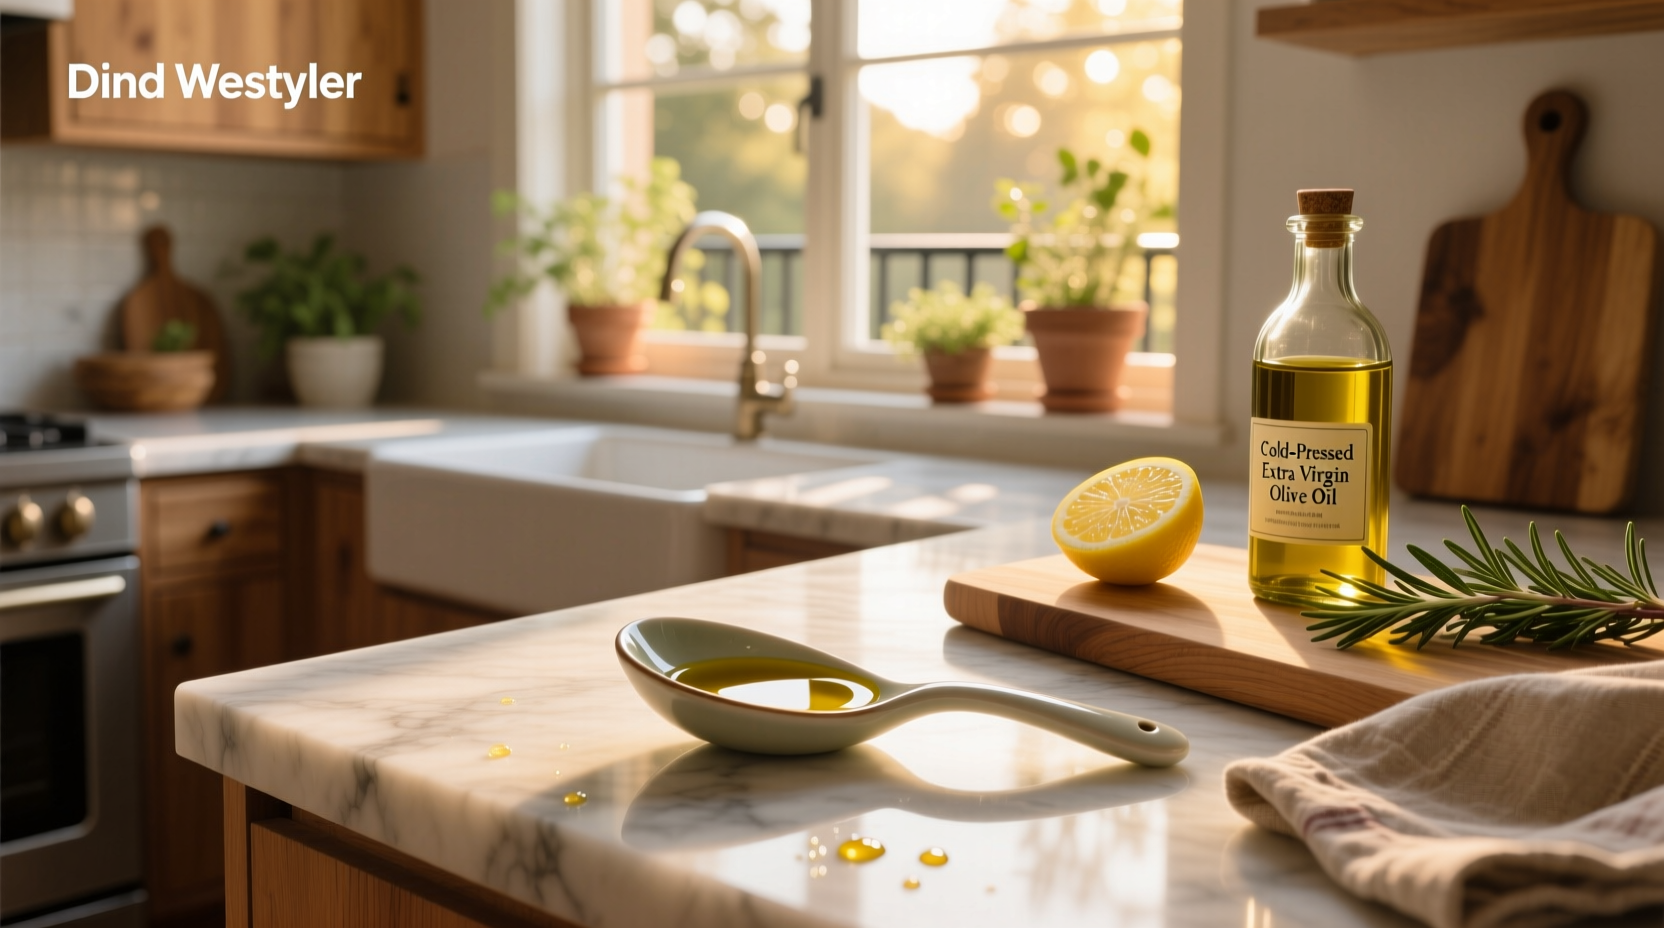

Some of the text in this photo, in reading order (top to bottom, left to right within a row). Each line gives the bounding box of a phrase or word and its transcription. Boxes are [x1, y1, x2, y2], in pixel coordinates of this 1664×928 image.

[1260, 440, 1354, 461] Cold-Pressed
[1262, 461, 1350, 488] Extra Virgin
[1269, 484, 1337, 506] Olive Oil
